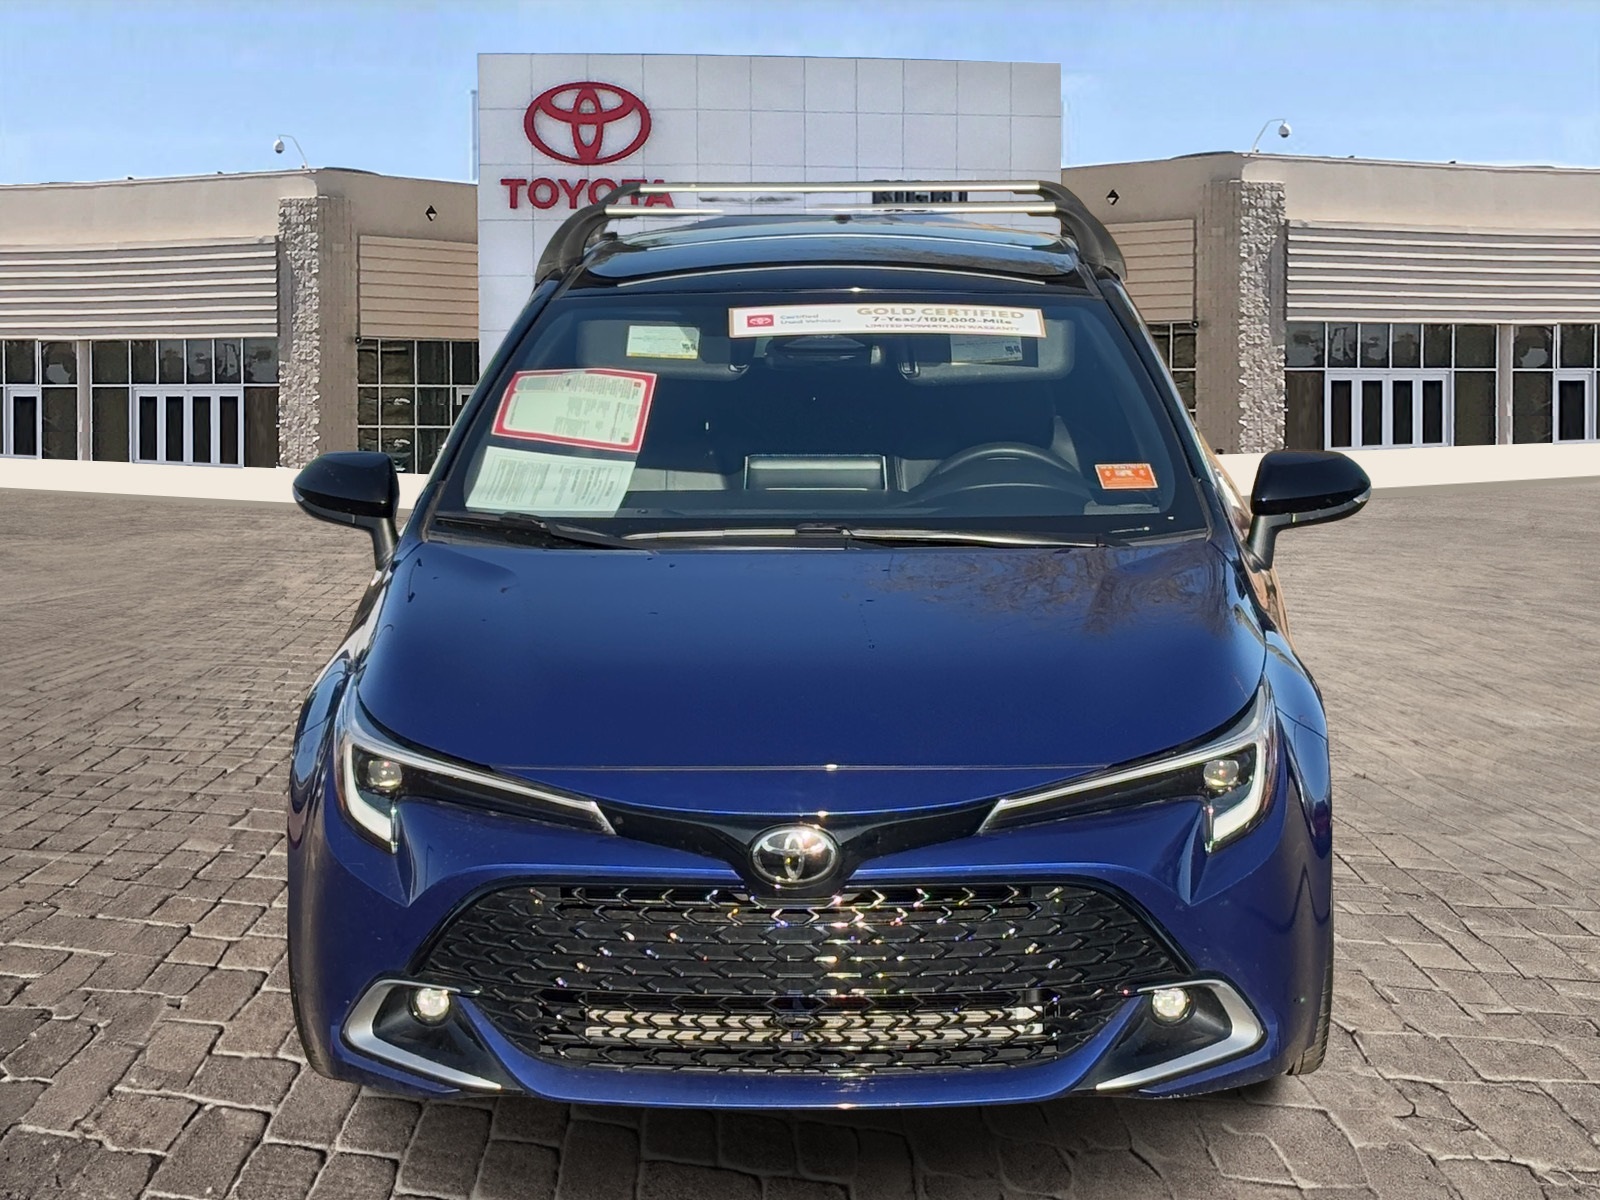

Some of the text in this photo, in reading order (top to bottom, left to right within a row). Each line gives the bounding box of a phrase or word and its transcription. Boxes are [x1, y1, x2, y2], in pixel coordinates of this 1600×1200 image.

[501, 178, 675, 209] TOYOTA
[857, 307, 1024, 319] GOLD CERTIFIED
